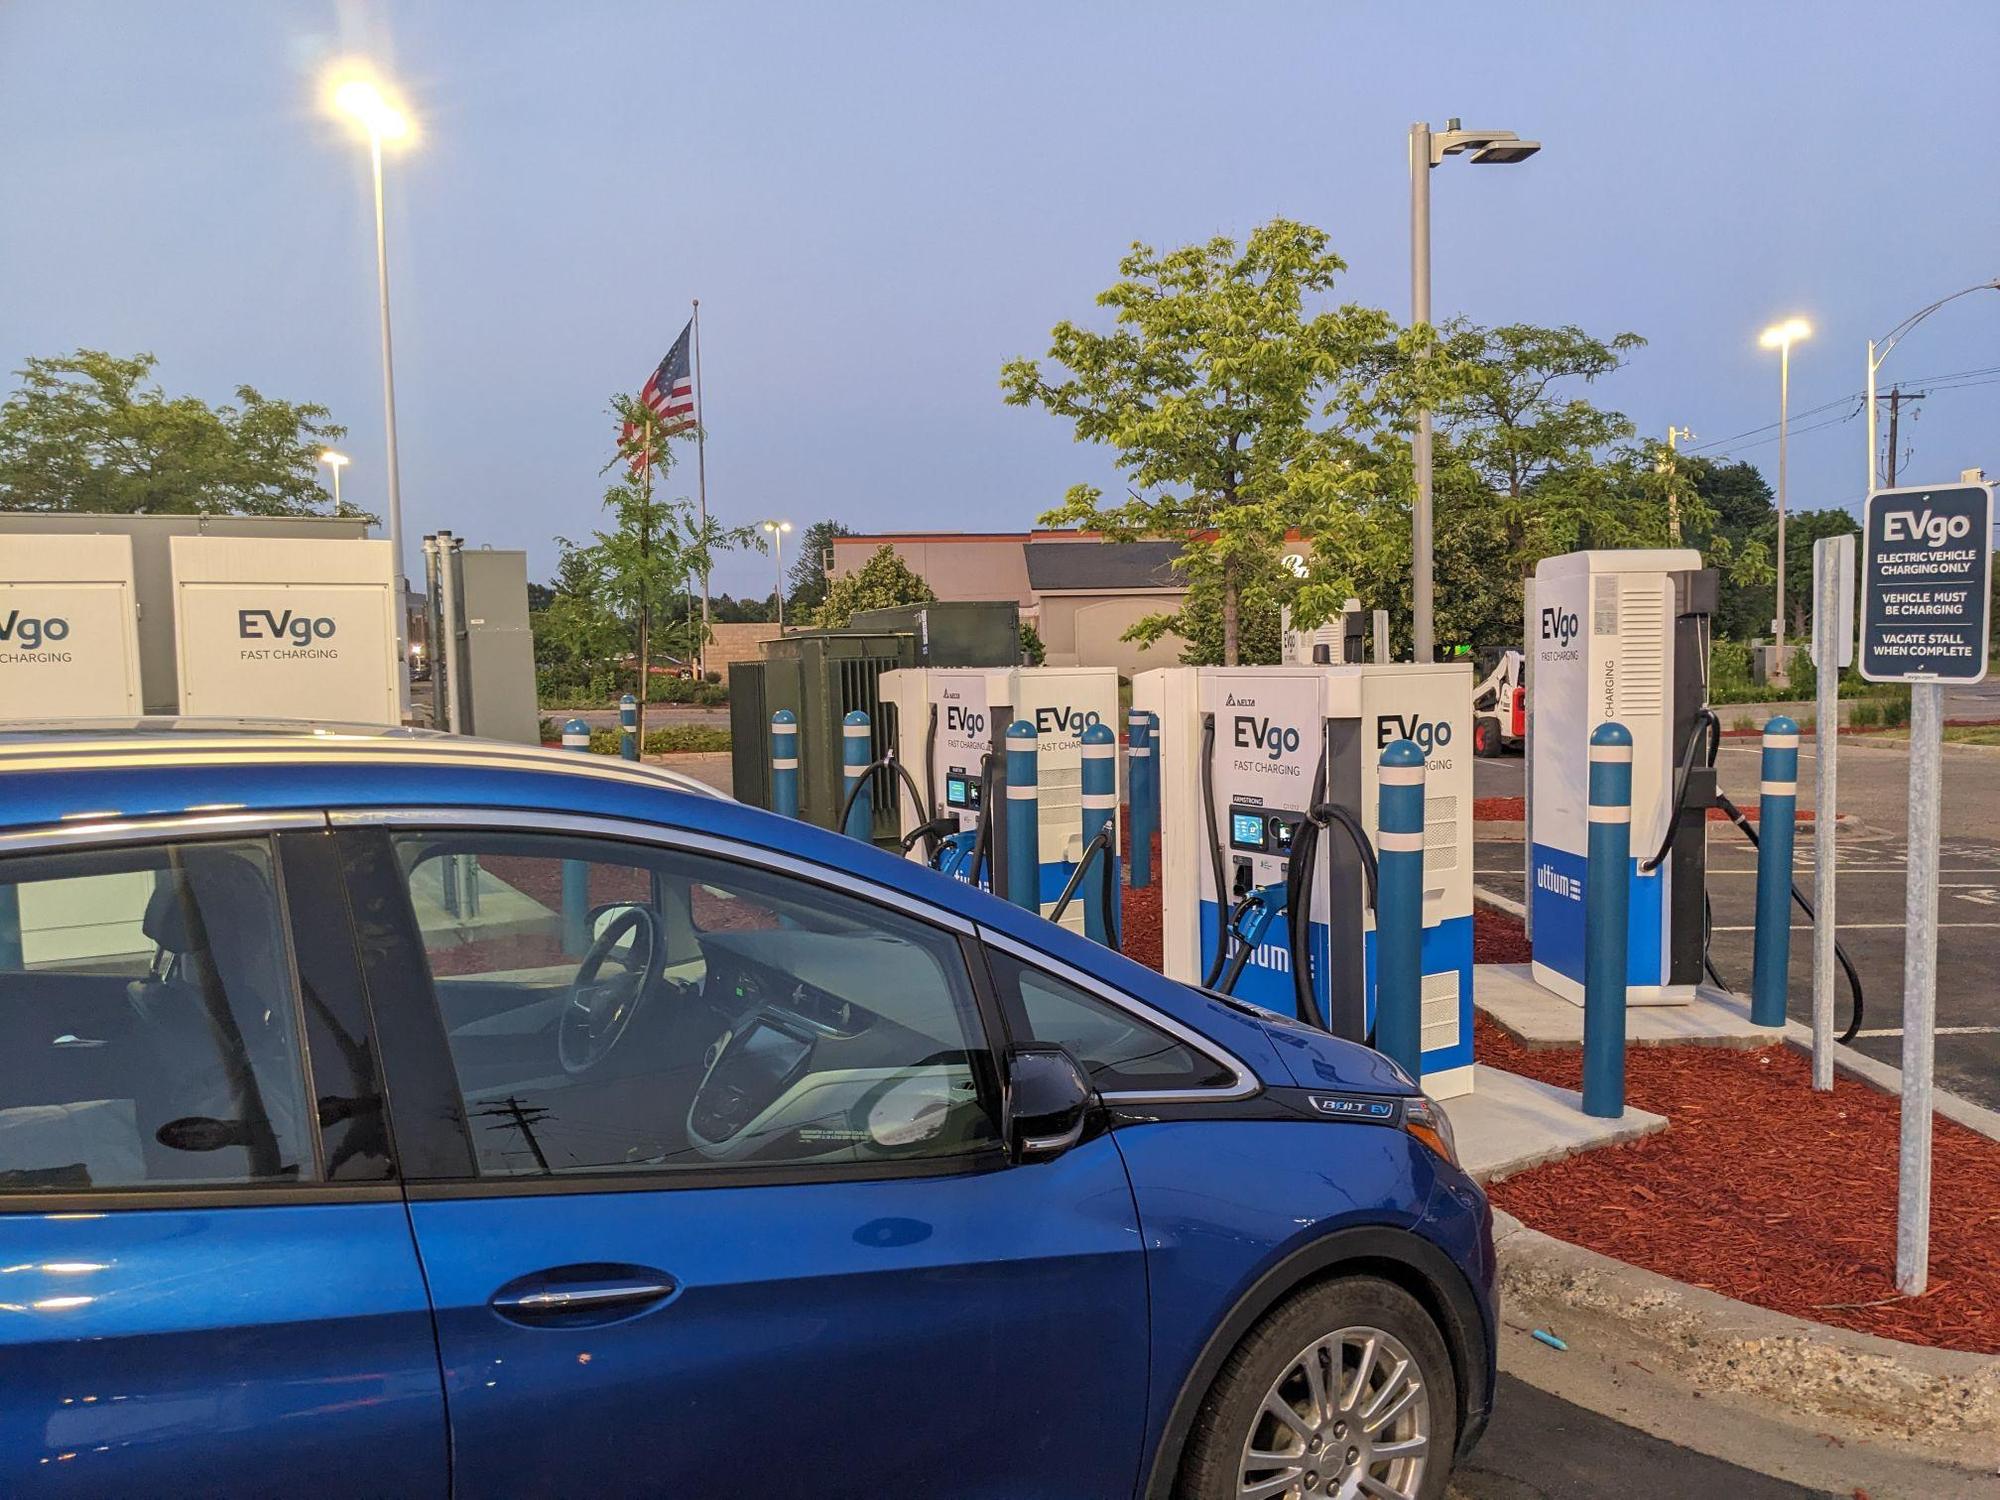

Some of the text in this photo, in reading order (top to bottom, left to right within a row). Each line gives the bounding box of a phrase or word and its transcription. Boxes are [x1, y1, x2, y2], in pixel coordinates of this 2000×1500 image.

[1883, 509, 1971, 547] EVgo
[1877, 550, 1976, 564] ELECTRIC VEHICLE
[1881, 562, 1971, 576] CHARGING ONLY
[1882, 592, 1967, 604] VEHICLE MUST
[1885, 604, 1963, 615] BE CHARGING
[238, 609, 336, 647] EVgo
[1542, 607, 1578, 647] EVgo
[1882, 634, 1964, 644] VACATE STALL
[0, 652, 72, 663] CHARGING
[241, 649, 338, 660] FAST CHARGING
[1541, 650, 1579, 662] FAST CHARGING
[1874, 646, 1973, 657] WHEN COMPLETE
[1605, 660, 1614, 718] CHARGING
[948, 706, 984, 739] EVgo
[1036, 706, 1100, 738] EVgo
[1234, 716, 1300, 760] EVgo
[1377, 714, 1451, 757] EVgo
[1059, 741, 1081, 750] CHAR
[1234, 760, 1300, 776] FAST CHARGING
[1424, 759, 1452, 771] RGING
[1537, 863, 1569, 897] ultium
[1371, 1104, 1390, 1114] EV
